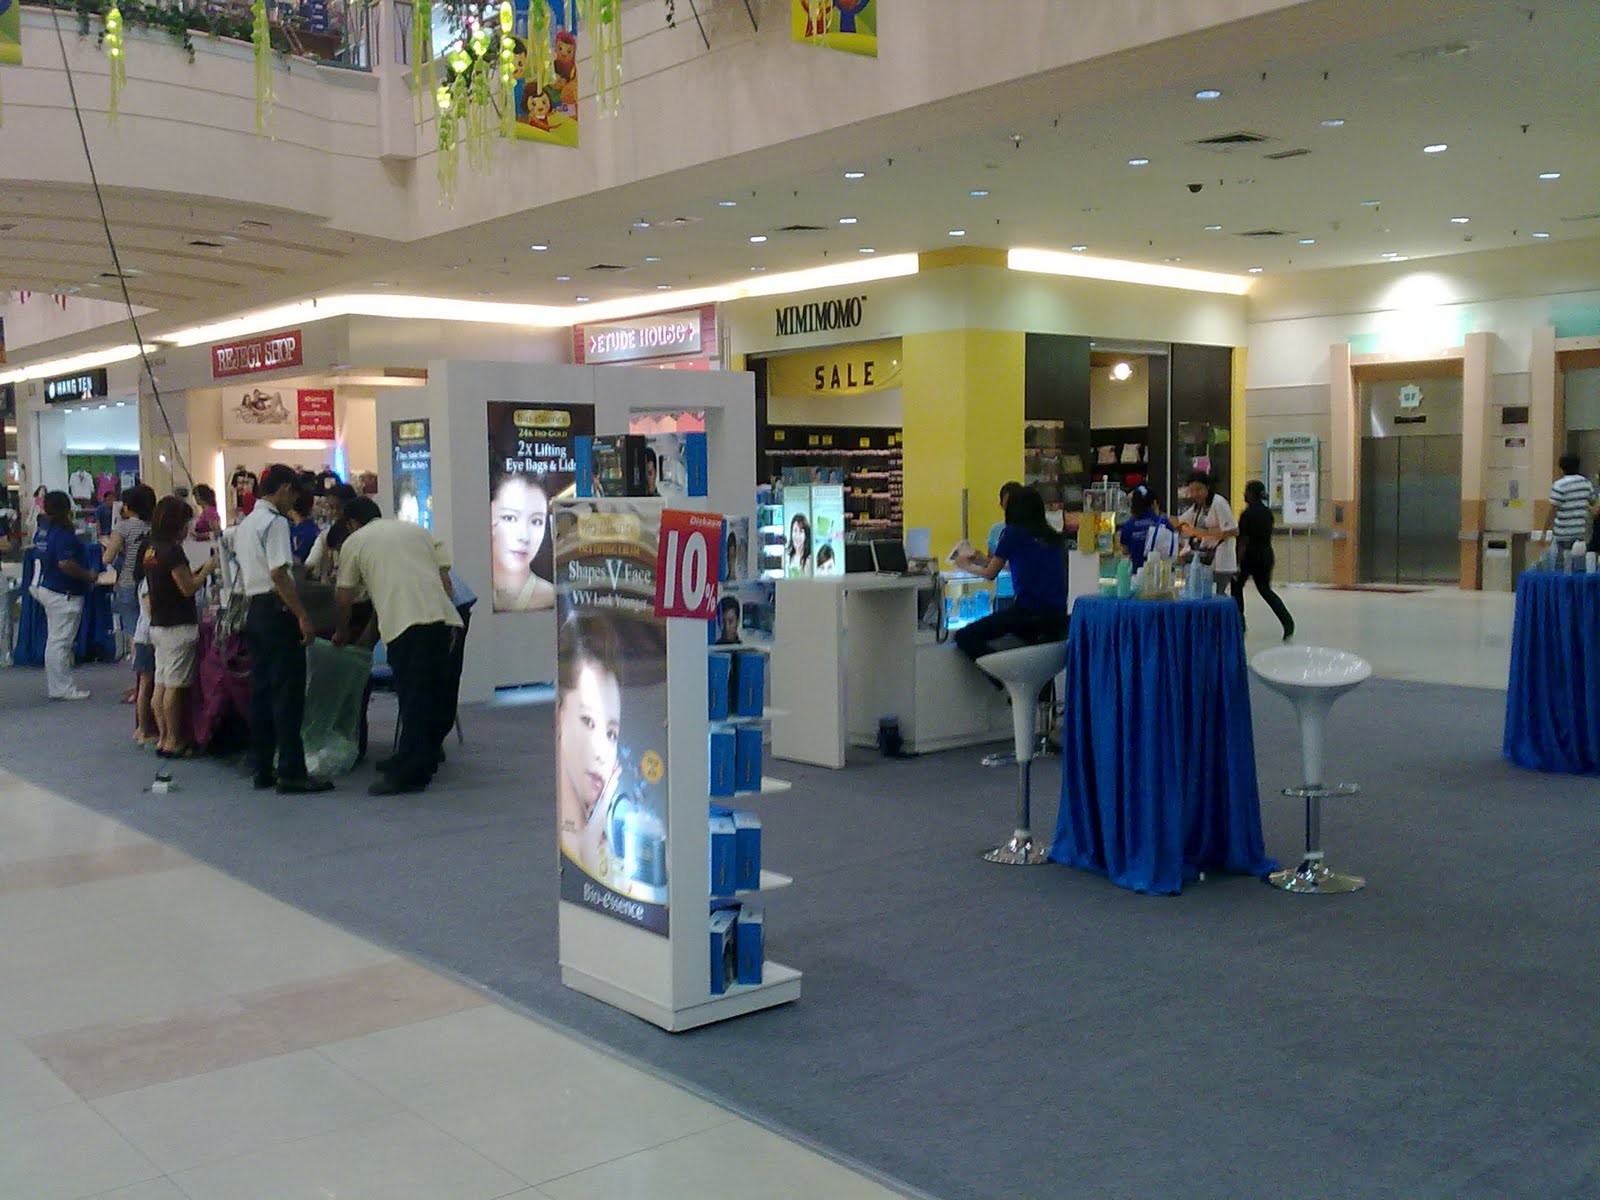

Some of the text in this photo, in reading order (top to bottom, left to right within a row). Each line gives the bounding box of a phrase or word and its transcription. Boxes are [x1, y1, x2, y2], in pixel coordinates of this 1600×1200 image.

[775, 297, 862, 336] MIMIMOMO
[216, 337, 296, 371] REJECT SHOP
[597, 329, 637, 353] ETUDE
[815, 361, 874, 389] SALE
[534, 442, 567, 460] Lifting
[506, 458, 524, 475] Eye
[525, 458, 548, 475] Bags
[549, 460, 557, 471] &
[568, 559, 652, 590] Shapes V Face
[583, 882, 644, 920] Bio-essence
